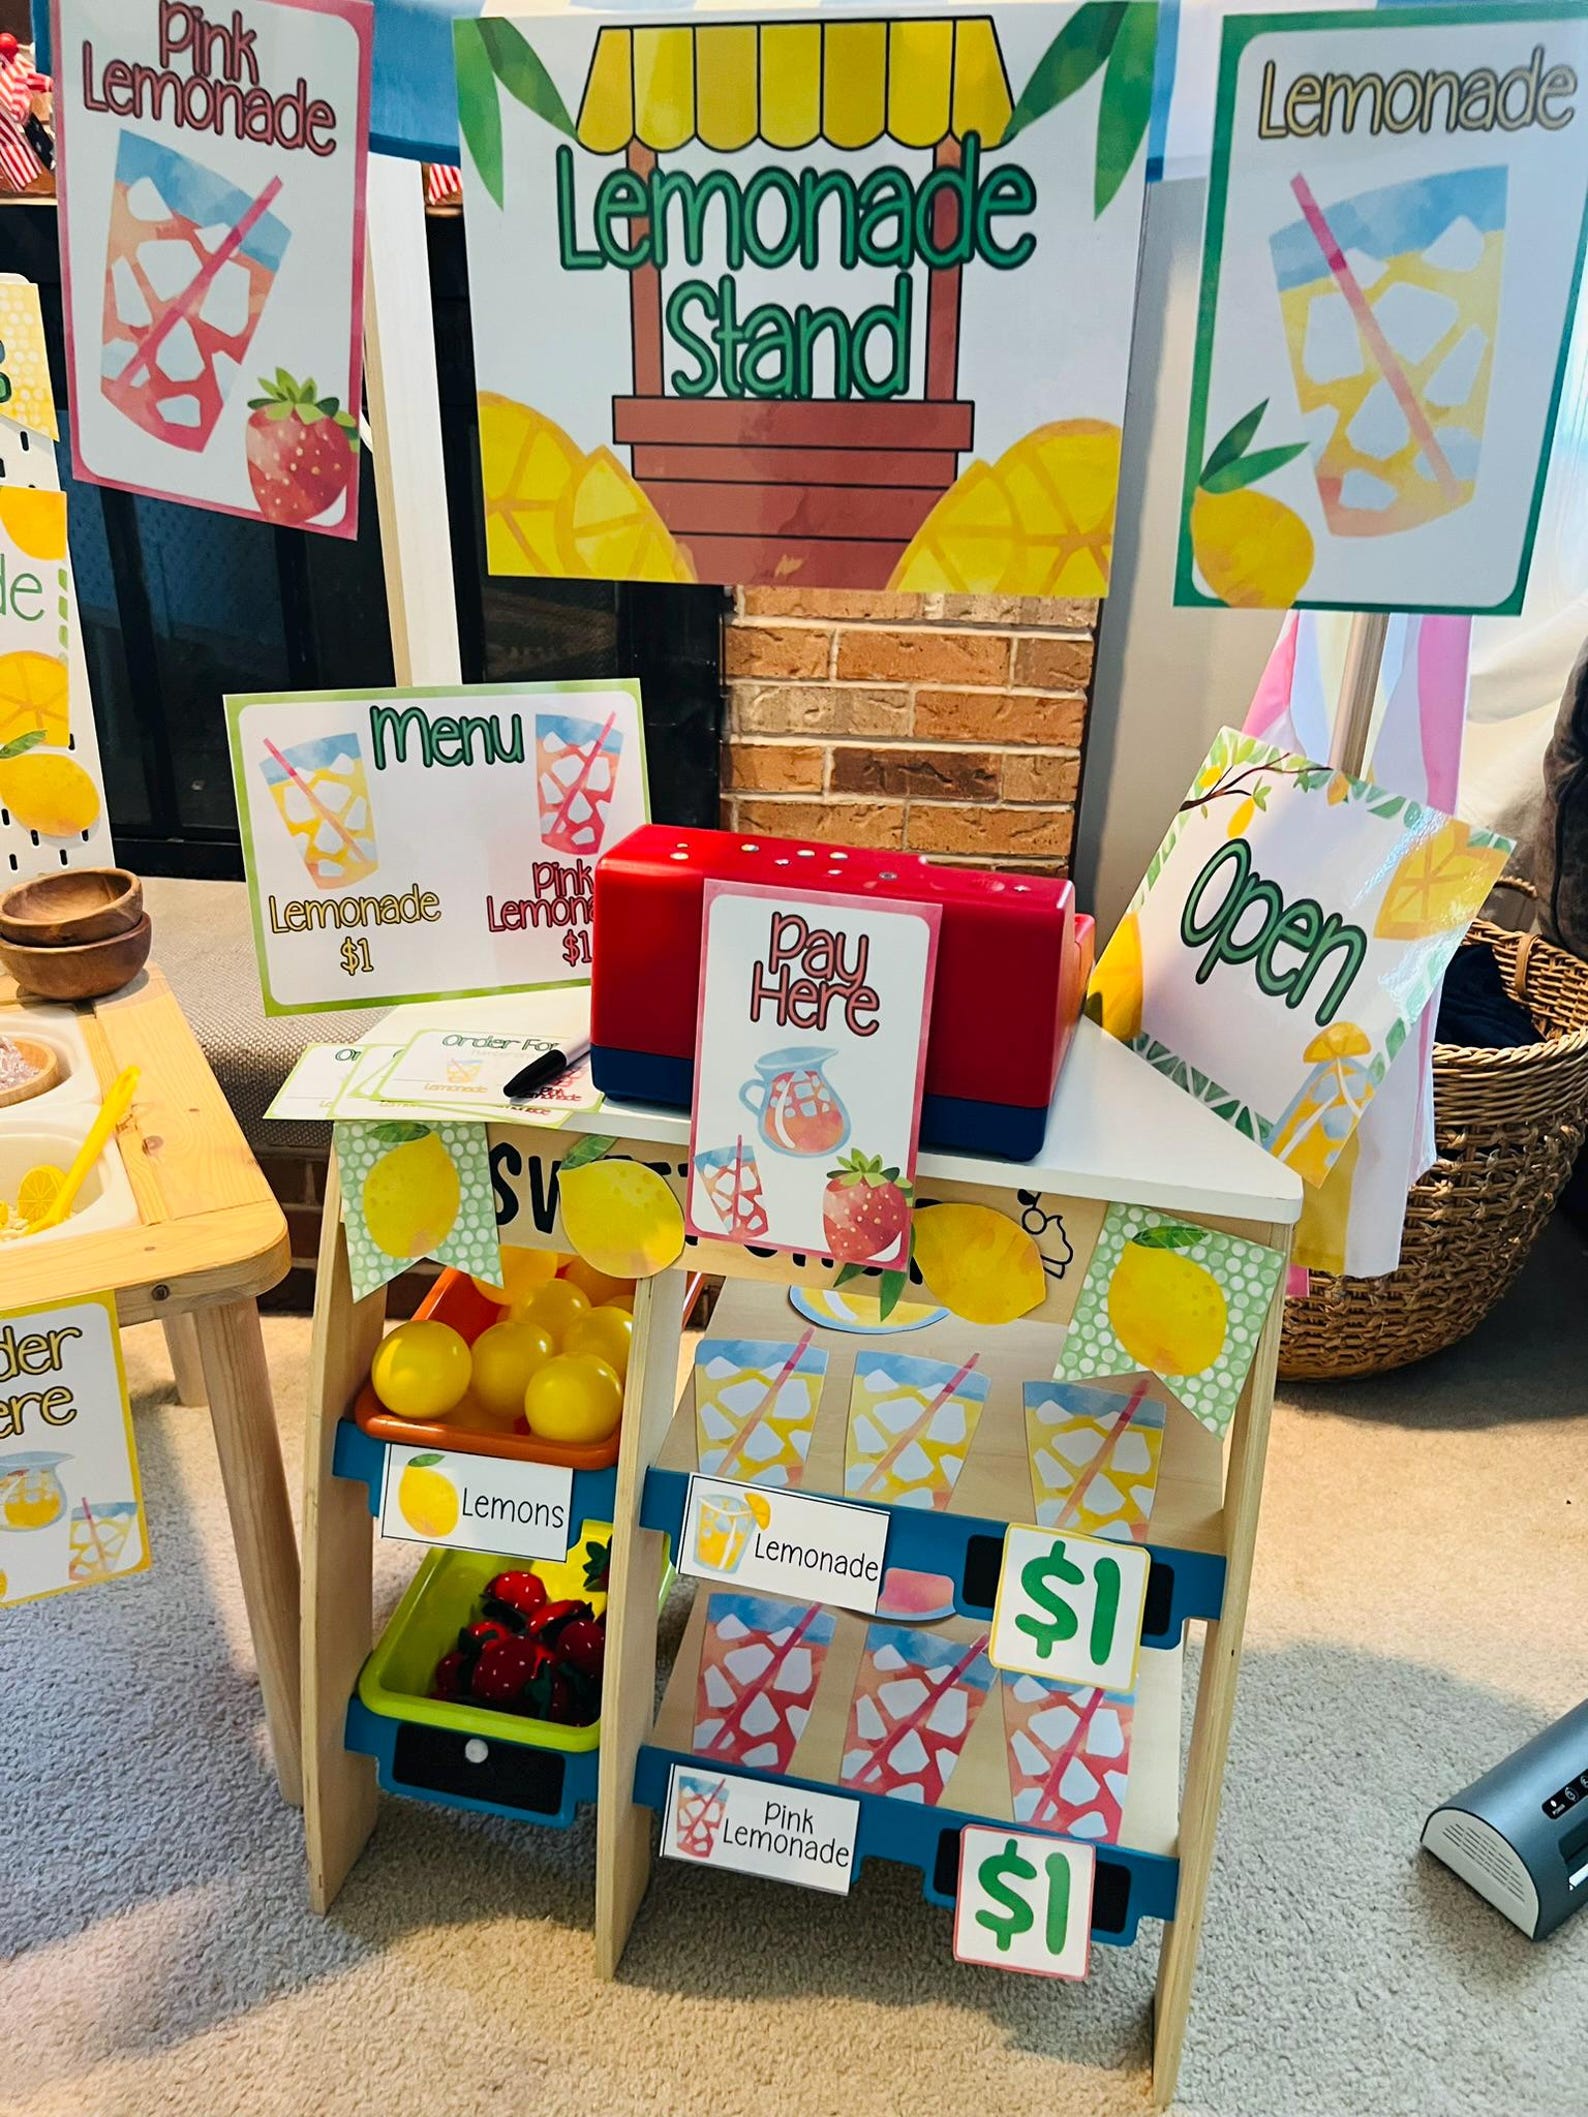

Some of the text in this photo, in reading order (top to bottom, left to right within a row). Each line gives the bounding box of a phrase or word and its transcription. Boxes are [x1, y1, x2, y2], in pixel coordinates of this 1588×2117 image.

[158, 0, 259, 84] Pink
[82, 40, 337, 156] Lemonade
[1257, 44, 1578, 140] Lemonade
[556, 130, 1037, 271] Lemonade
[666, 271, 913, 400] Stand
[369, 706, 525, 770] Menu
[268, 883, 441, 933] Lemonade
[532, 858, 595, 899] Pink
[486, 895, 595, 932] Lemon
[1180, 837, 1368, 1027] Open
[340, 936, 374, 975] $1
[562, 928, 593, 967] $1
[769, 911, 870, 988] Pay
[750, 960, 880, 1037] Here
[442, 1033, 521, 1049] Order
[0, 1325, 83, 1382] der
[461, 1486, 565, 1530] Lemons
[754, 1532, 880, 1584] Lemonade
[1014, 1539, 1121, 1666] $1
[723, 1818, 850, 1869] Lemonade
[764, 1800, 814, 1835] Pink
[975, 1838, 1071, 1956] $1
